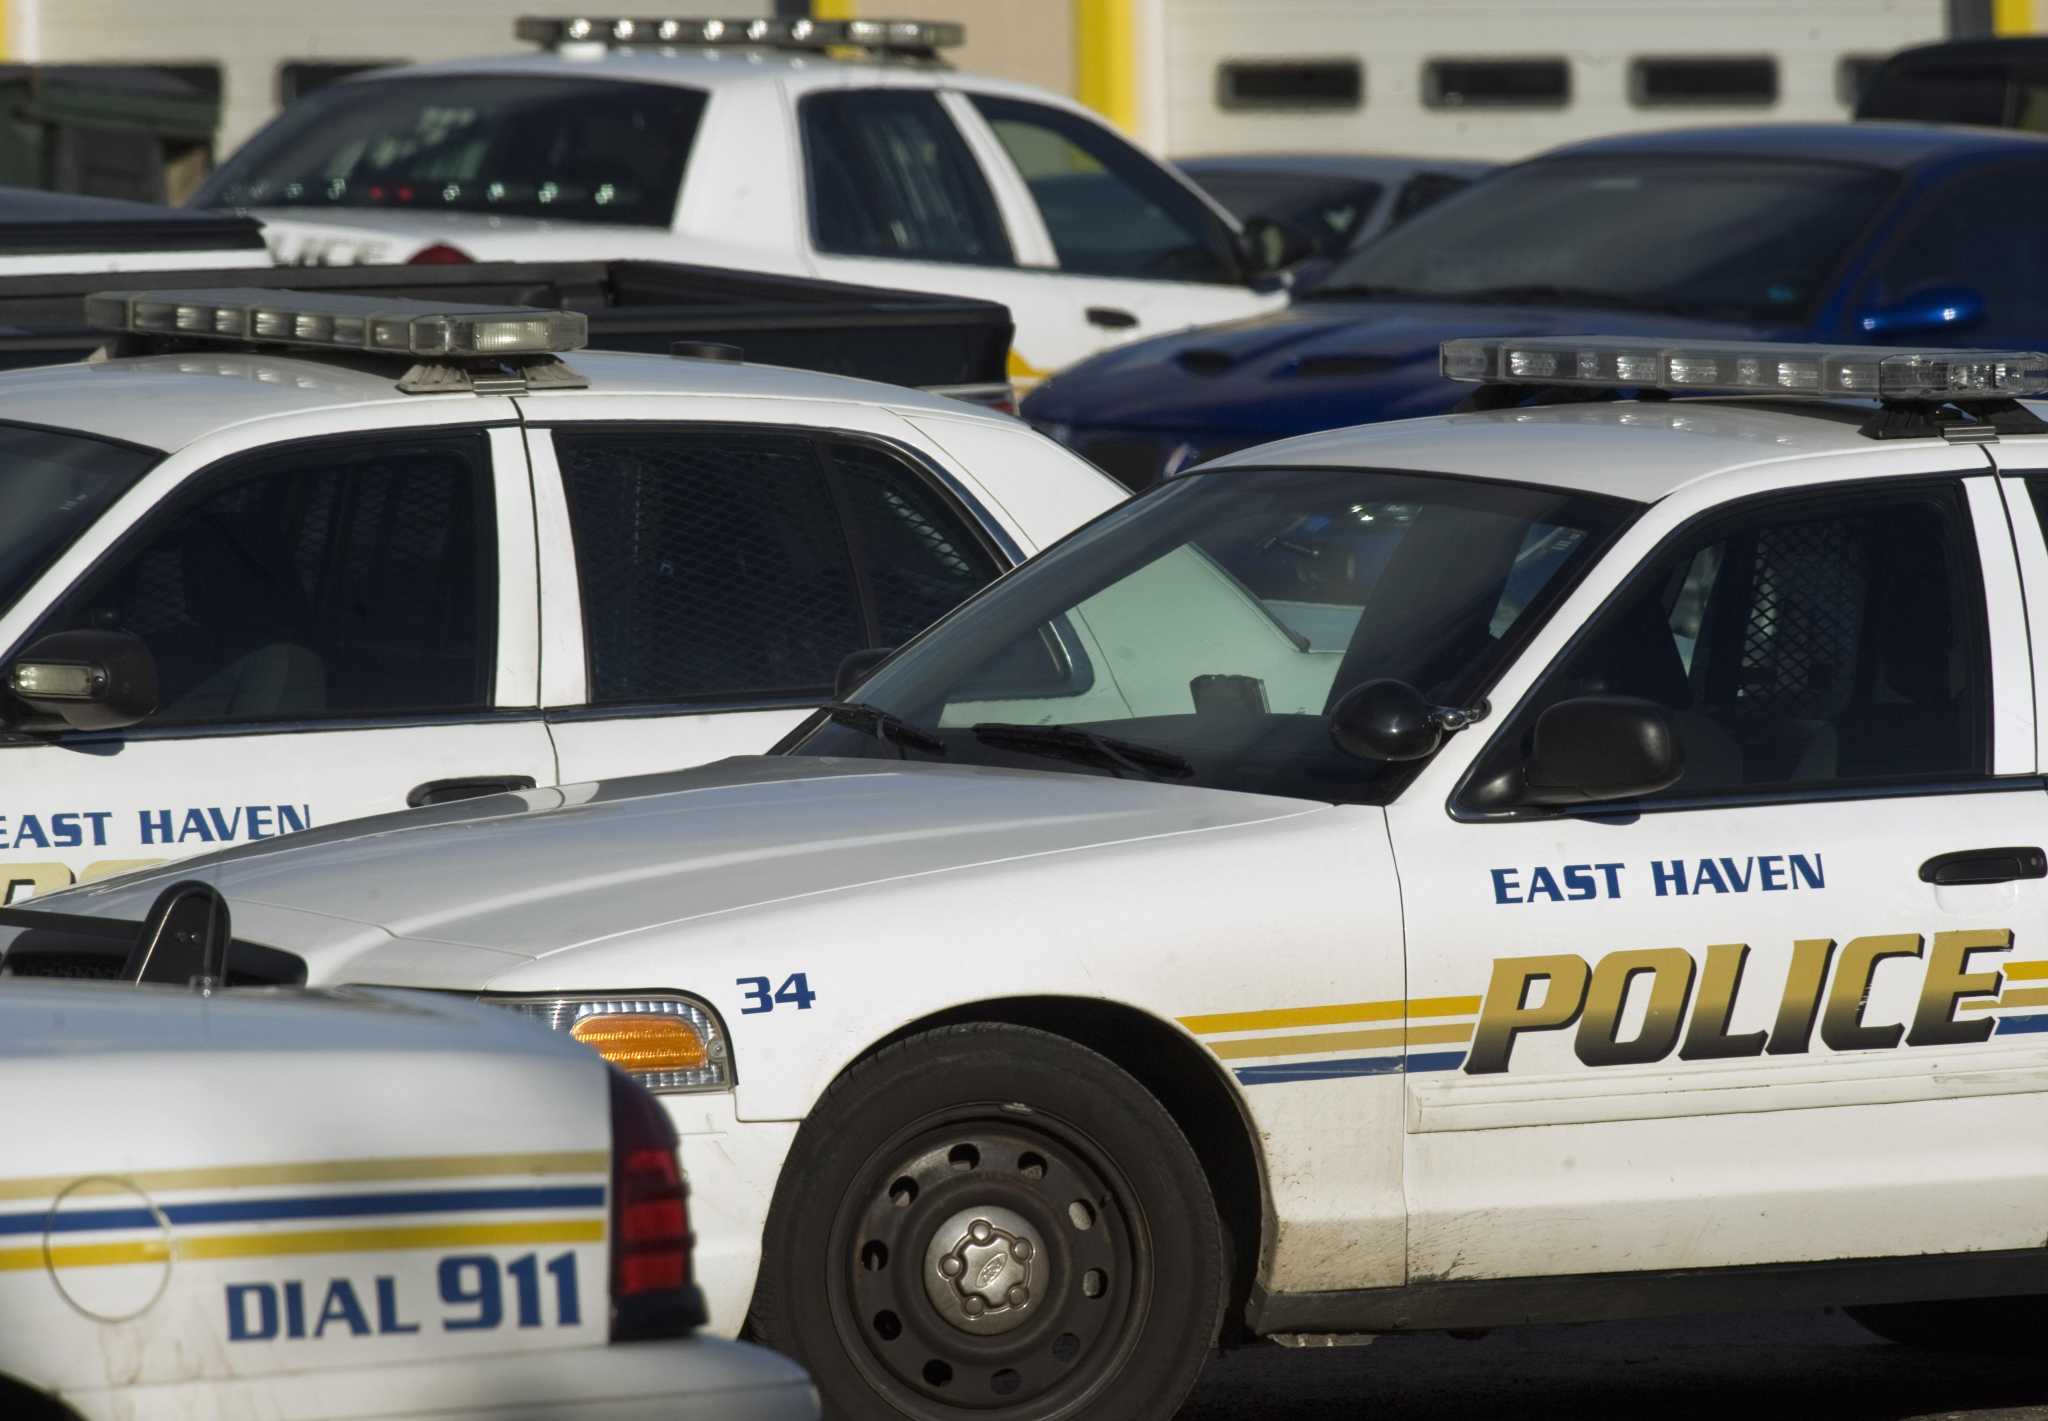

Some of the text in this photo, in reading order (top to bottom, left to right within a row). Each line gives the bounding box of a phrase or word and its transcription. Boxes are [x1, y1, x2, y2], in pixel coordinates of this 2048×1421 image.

[138, 804, 310, 845] HAVEN
[1490, 853, 1825, 904] EAST HAVEN
[736, 972, 816, 1015] 34
[1463, 928, 2015, 1074] POLICE
[225, 1250, 581, 1342] DIAL 911
